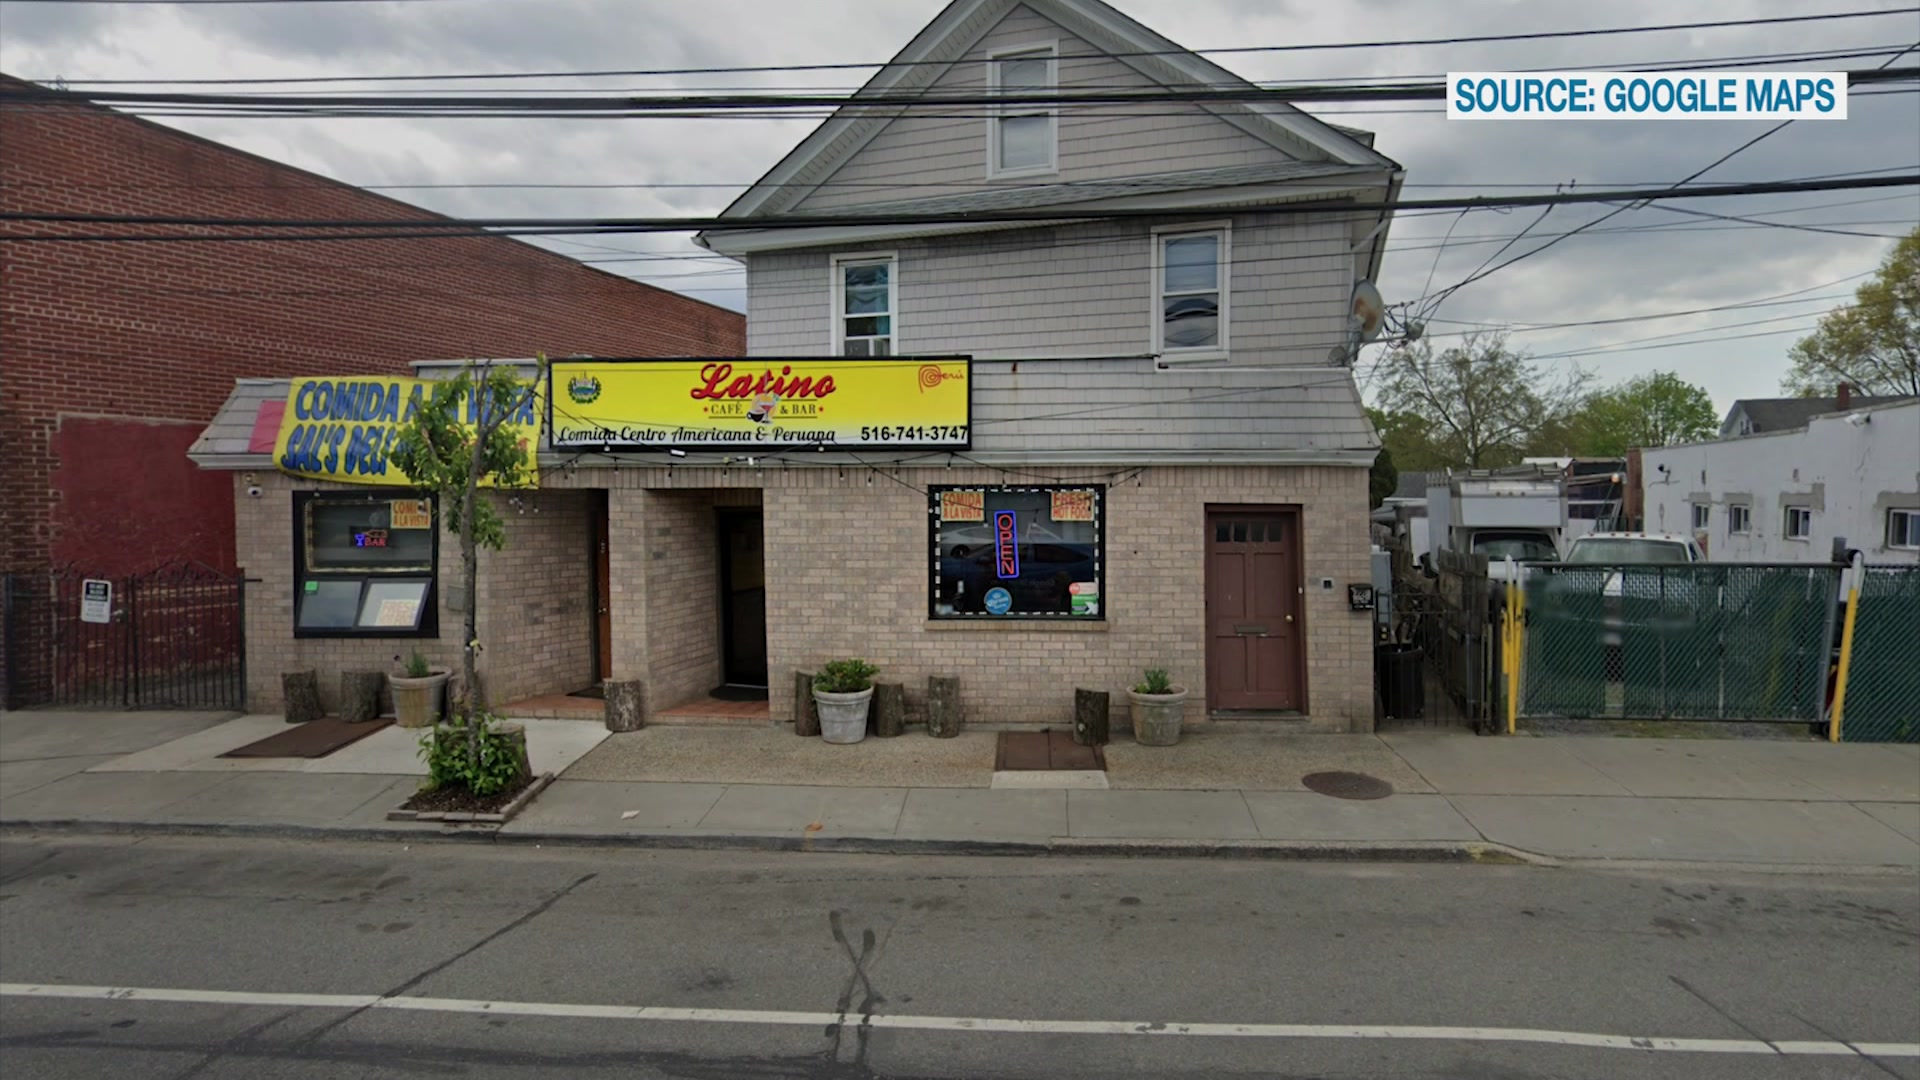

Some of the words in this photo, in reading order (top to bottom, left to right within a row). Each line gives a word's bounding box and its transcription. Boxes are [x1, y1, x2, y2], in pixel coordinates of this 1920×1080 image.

[690, 363, 837, 399] Latino
[295, 381, 400, 422] COMIDA
[711, 400, 743, 415] CAFÉ
[780, 404, 789, 415] &
[792, 404, 816, 414] BAR
[557, 425, 617, 444] Comida
[620, 425, 666, 441] Centro
[671, 426, 751, 443] Americana
[755, 426, 768, 441] &
[771, 426, 836, 443] Peruana
[860, 426, 969, 441] 516-741-3747
[281, 424, 346, 474] SAL'S
[943, 493, 982, 507] COMIDA
[1053, 492, 1093, 507] FRESH
[364, 536, 386, 547] BAR
[997, 513, 1015, 576] OPEN
